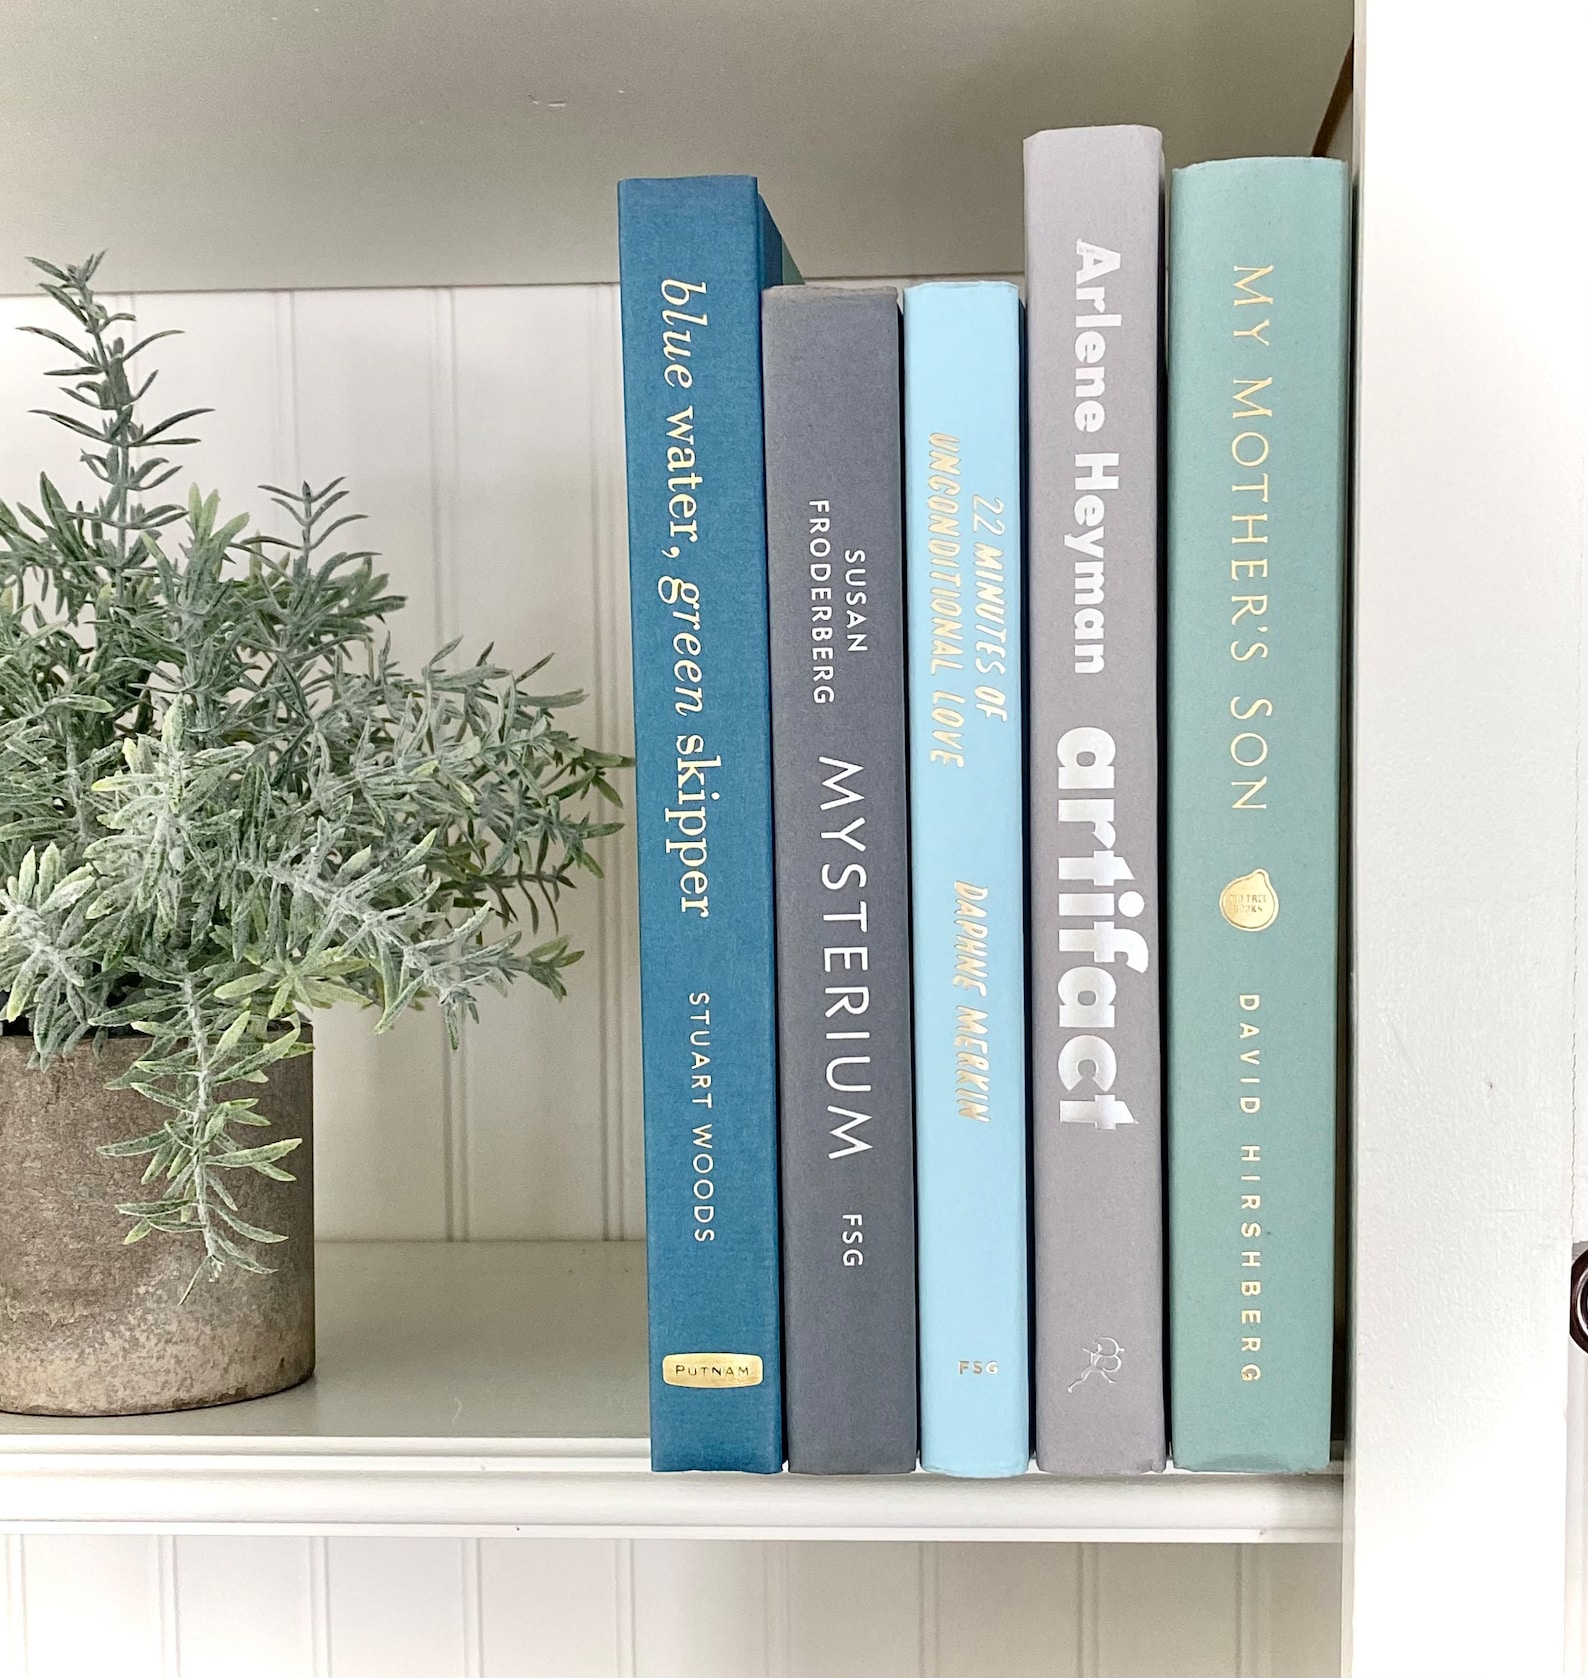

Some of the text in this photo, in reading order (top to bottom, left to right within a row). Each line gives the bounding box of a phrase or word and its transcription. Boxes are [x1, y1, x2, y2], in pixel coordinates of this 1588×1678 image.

[657, 279, 722, 917] blue water, green skipper
[809, 500, 835, 704] FRODERBERG
[844, 549, 867, 652] SUSAN
[927, 432, 965, 768] UNCONDITIONAL LOVE
[1065, 239, 1122, 674] Arlene Heyman
[1231, 265, 1274, 808] MY MOTHER'S SON
[972, 494, 1007, 723] 22 MINUTES OF
[819, 757, 872, 1159] MYSTERIUM
[953, 880, 991, 1122] DAPHNE MERKIN
[1056, 726, 1148, 1129] artifact
[688, 992, 715, 1241] STUART WOODS
[843, 1215, 864, 1267] FSG
[1240, 994, 1262, 1381] DAVID HIRSHBERG
[959, 1361, 998, 1374] FSG
